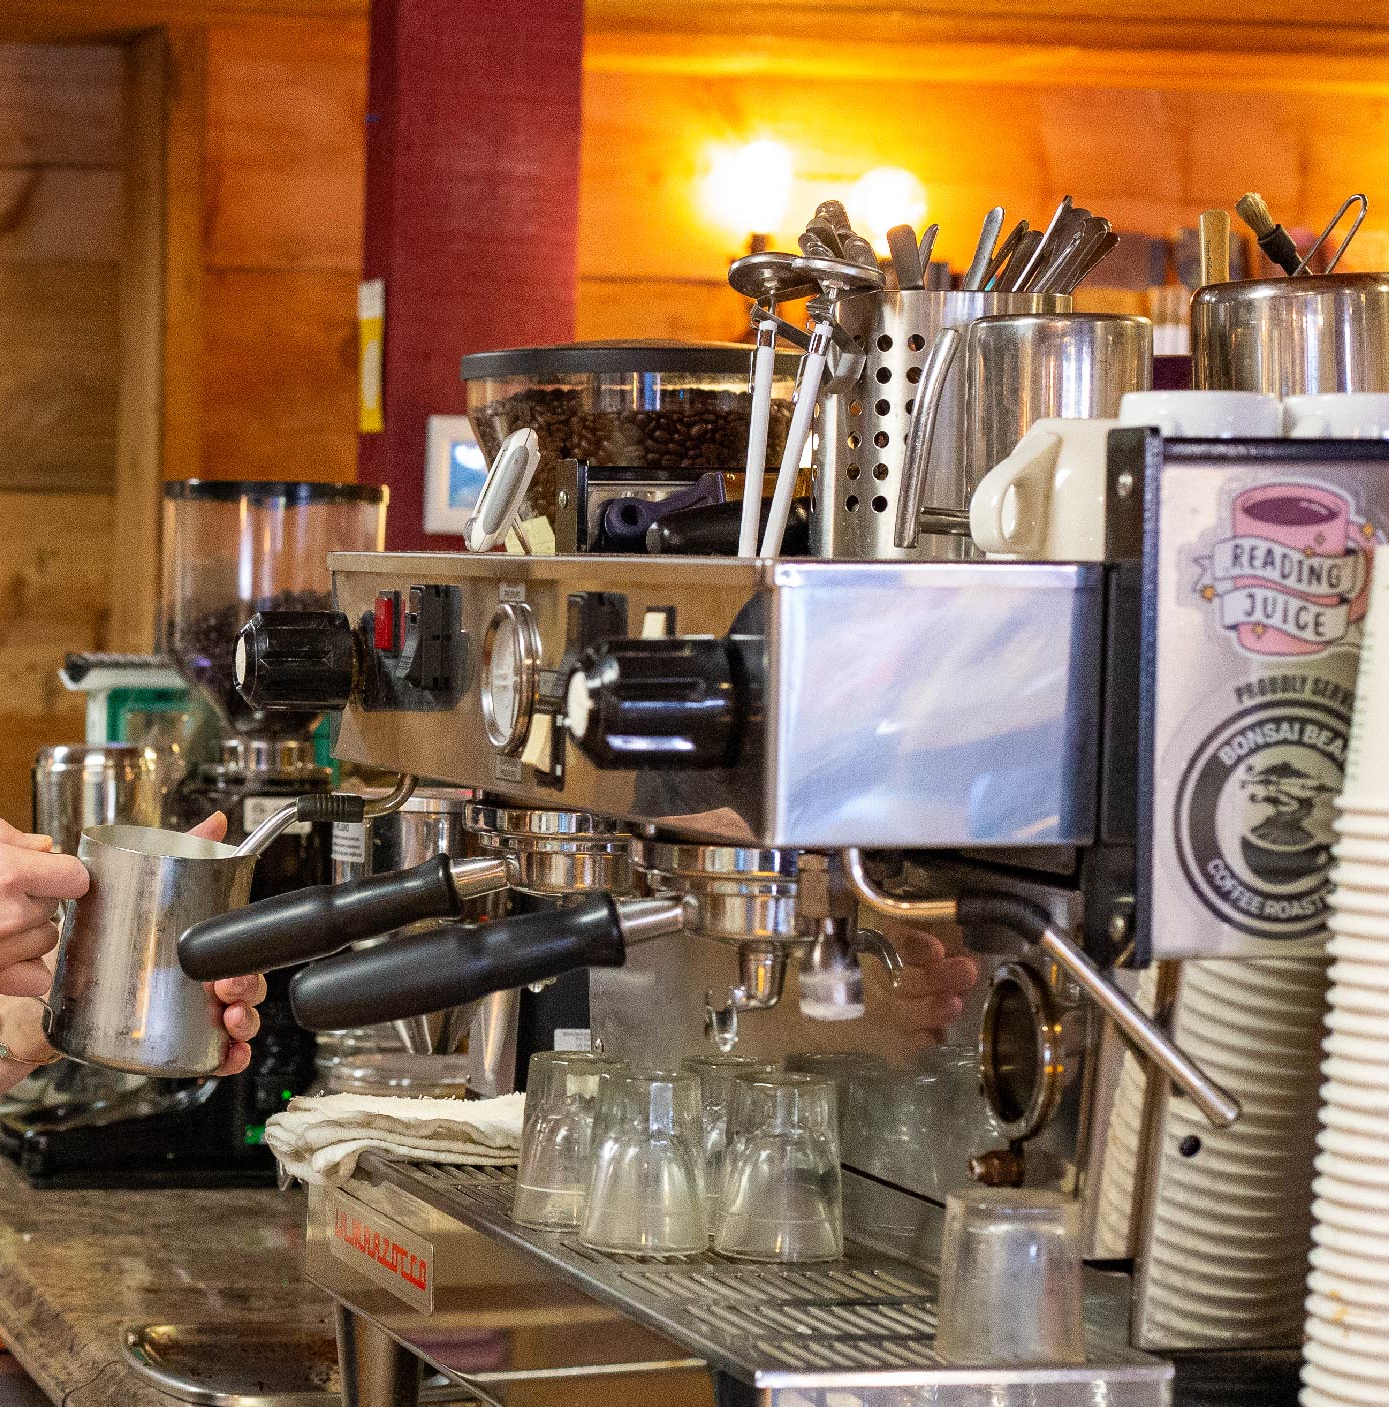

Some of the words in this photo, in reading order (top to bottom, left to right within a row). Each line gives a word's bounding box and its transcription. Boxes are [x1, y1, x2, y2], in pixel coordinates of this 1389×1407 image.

[1232, 543, 1341, 588] READING
[1244, 592, 1325, 636] JUICE
[1234, 674, 1308, 703] PROUDLY
[1218, 721, 1300, 765] BONSAI
[1303, 723, 1348, 763] BEA
[1207, 858, 1264, 914] COFFEE
